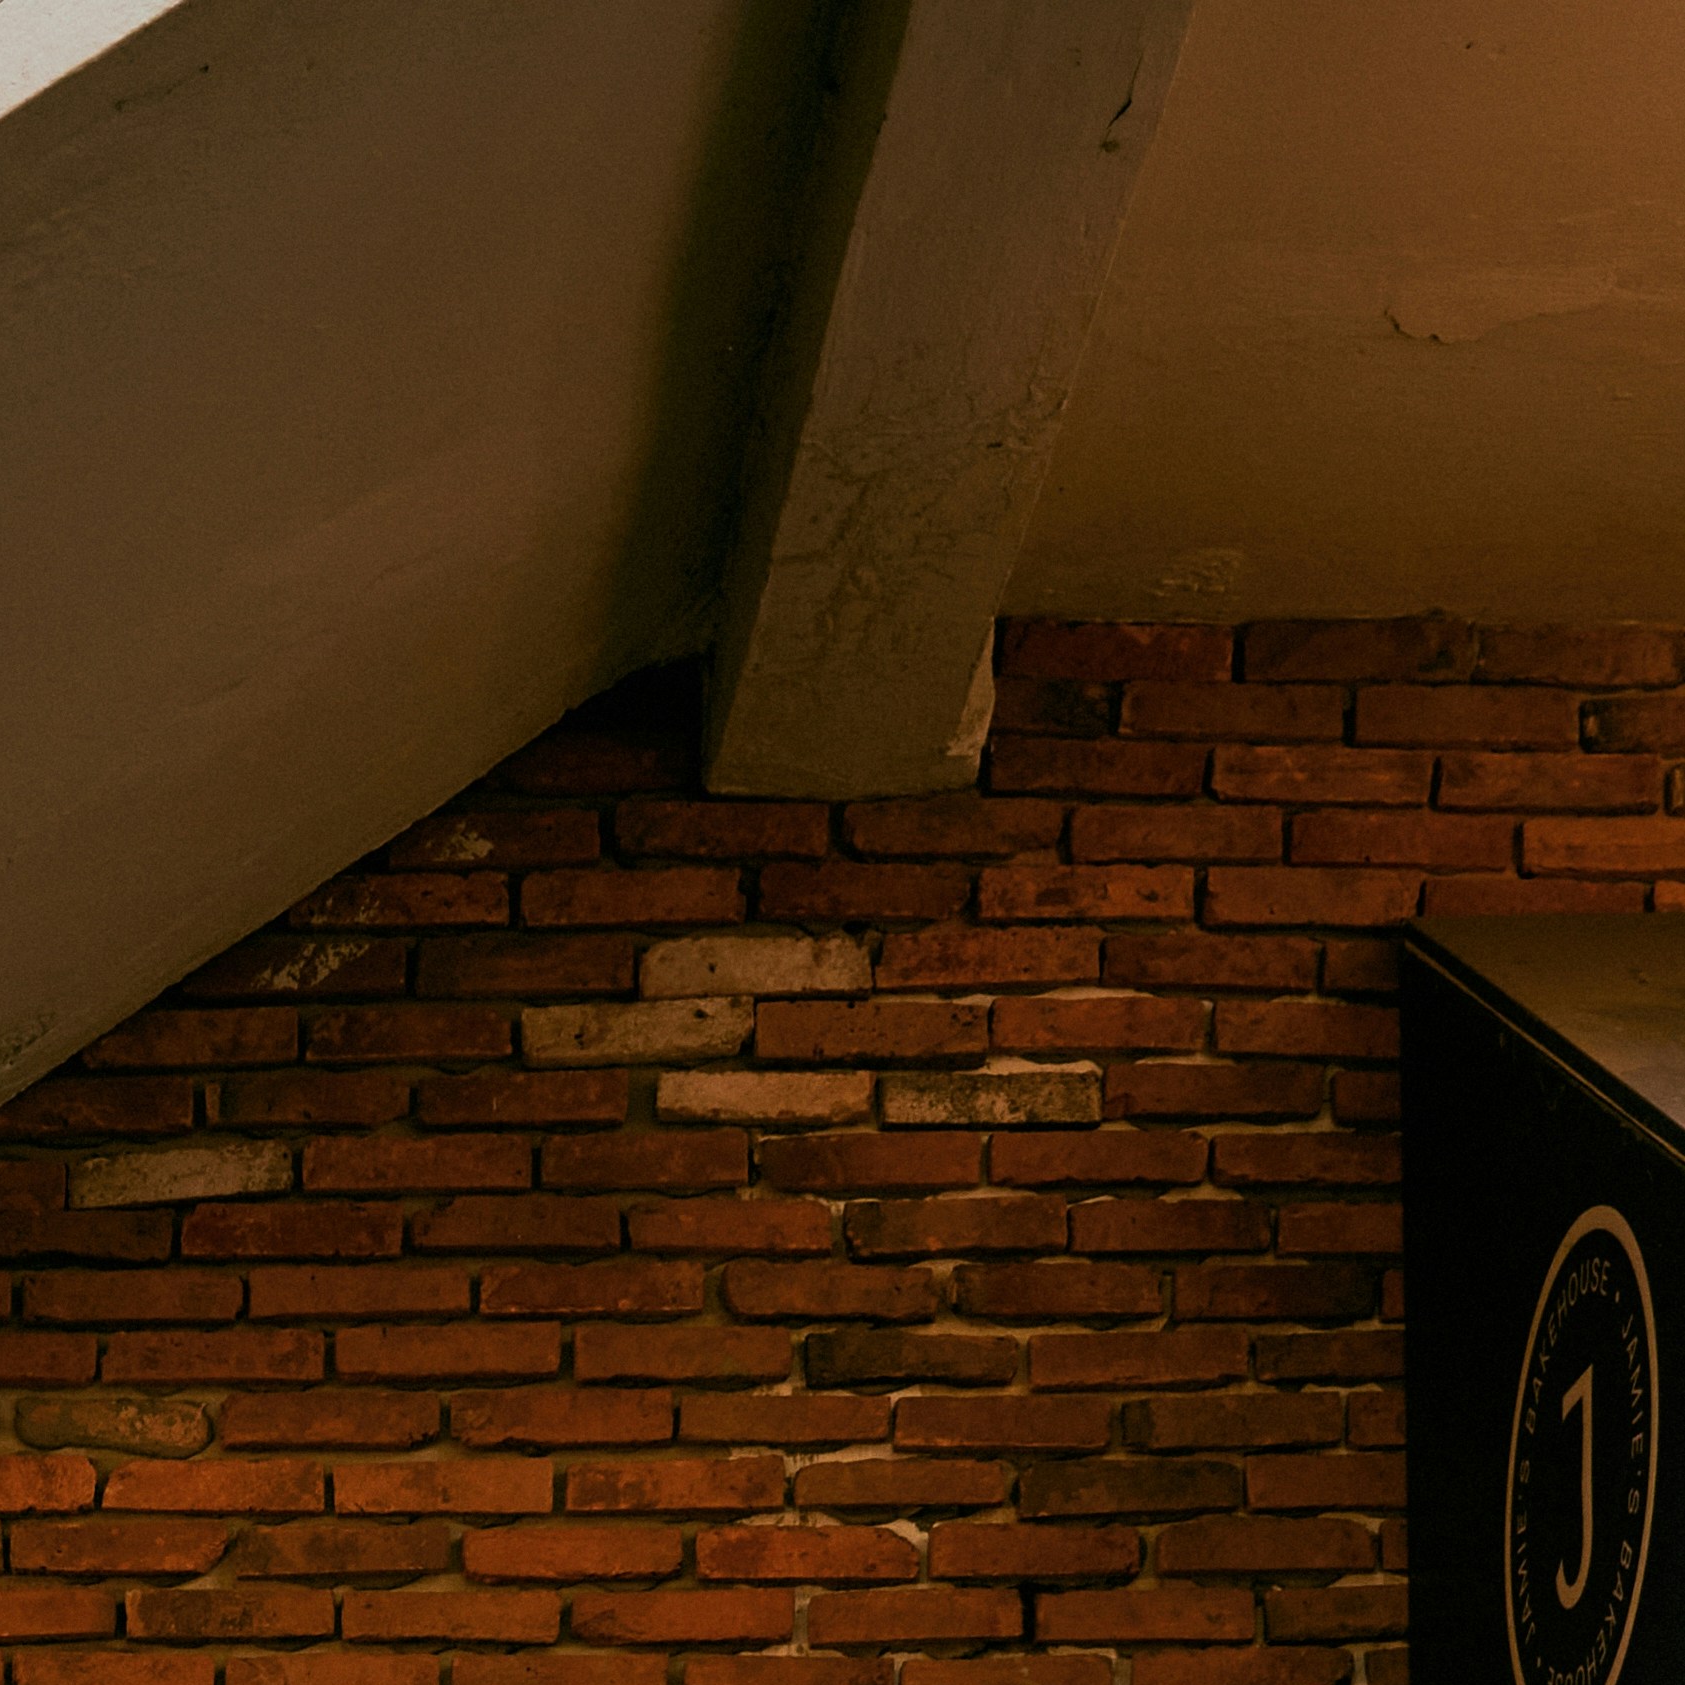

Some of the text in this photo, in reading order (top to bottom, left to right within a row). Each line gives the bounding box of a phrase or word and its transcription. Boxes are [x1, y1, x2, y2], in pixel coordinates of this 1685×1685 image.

[1516, 1256, 1611, 1645] JAMIE'S BAKEHOUSE
[1556, 1366, 1593, 1610] J
[1622, 1312, 1644, 1515] JAMIE'S
